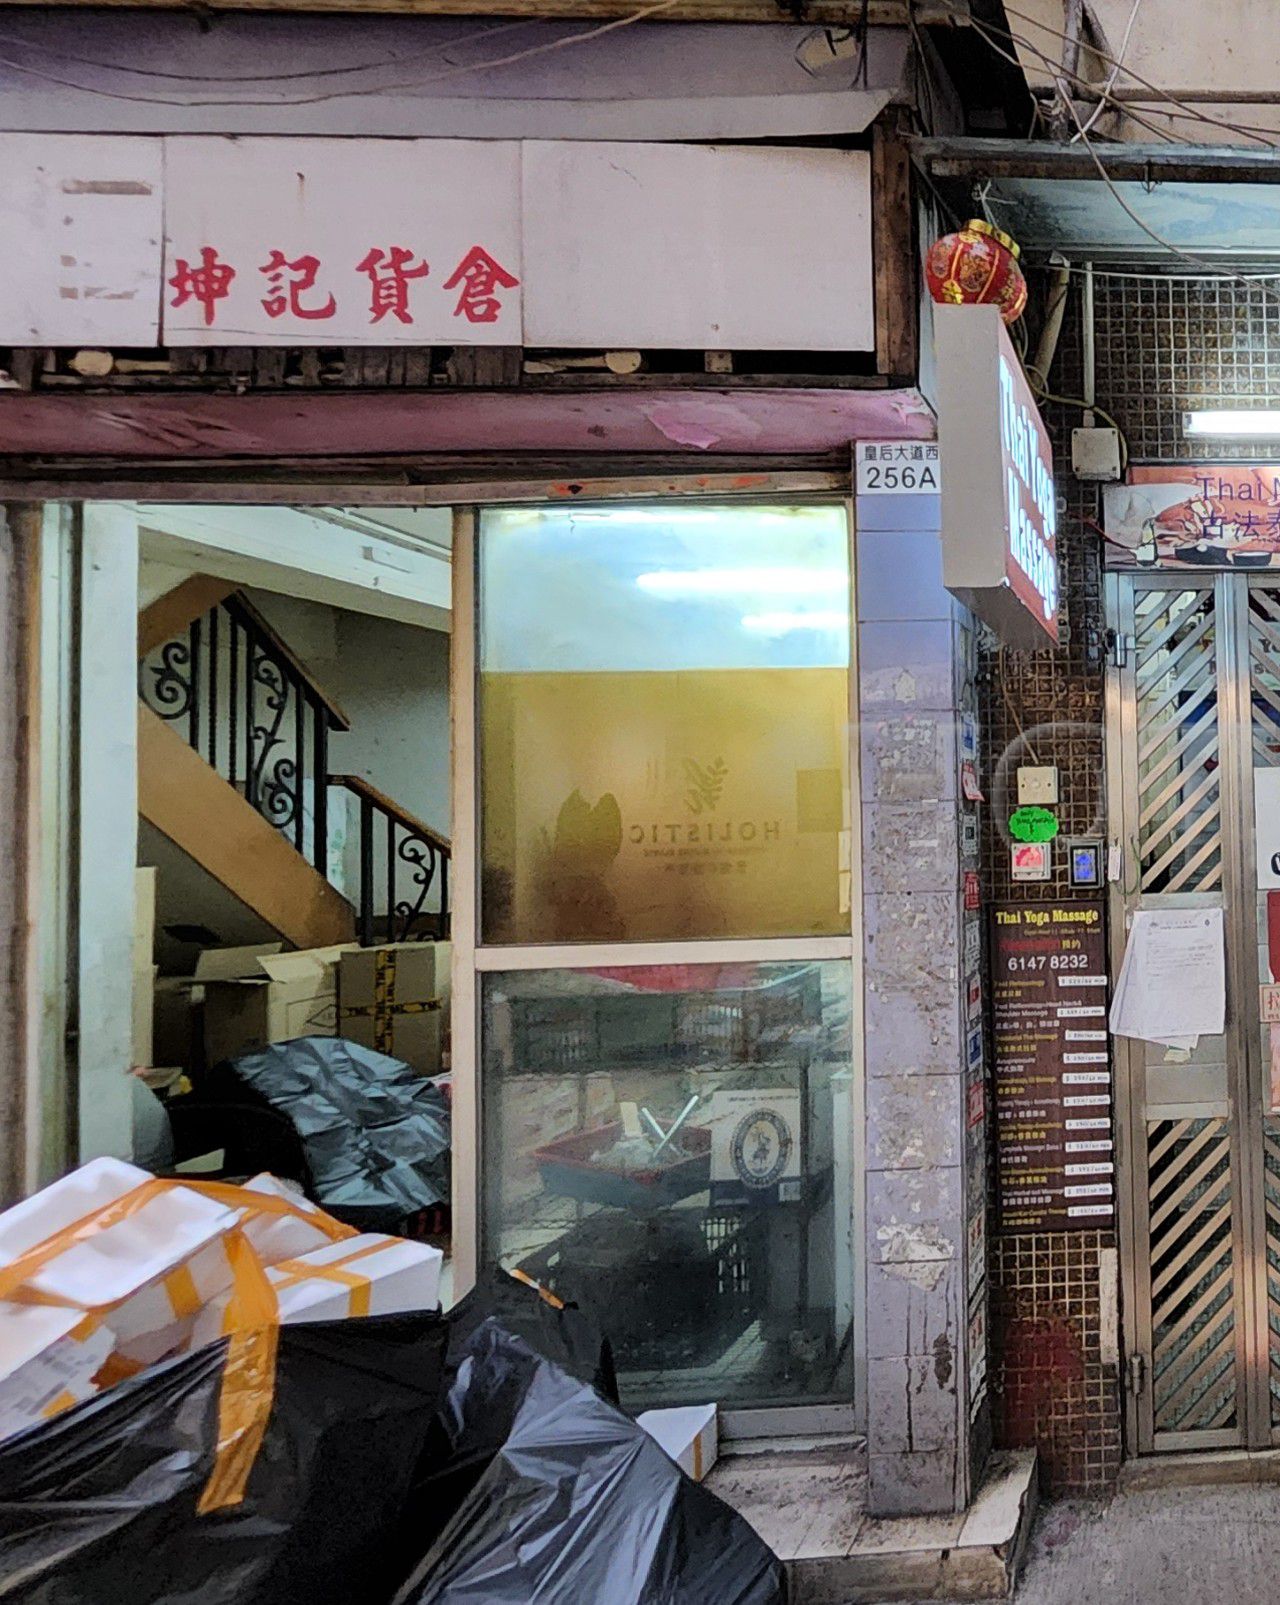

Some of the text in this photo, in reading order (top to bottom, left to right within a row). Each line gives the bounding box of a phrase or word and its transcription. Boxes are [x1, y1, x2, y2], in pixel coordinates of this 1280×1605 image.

[168, 245, 520, 326] 坤記貨倉
[864, 444, 939, 461] 皇后大道西
[866, 466, 937, 489] 256A
[1197, 477, 1263, 501] Thai
[995, 909, 1099, 926] Thai Yoga Massage
[1008, 954, 1088, 971] 6147 8232
